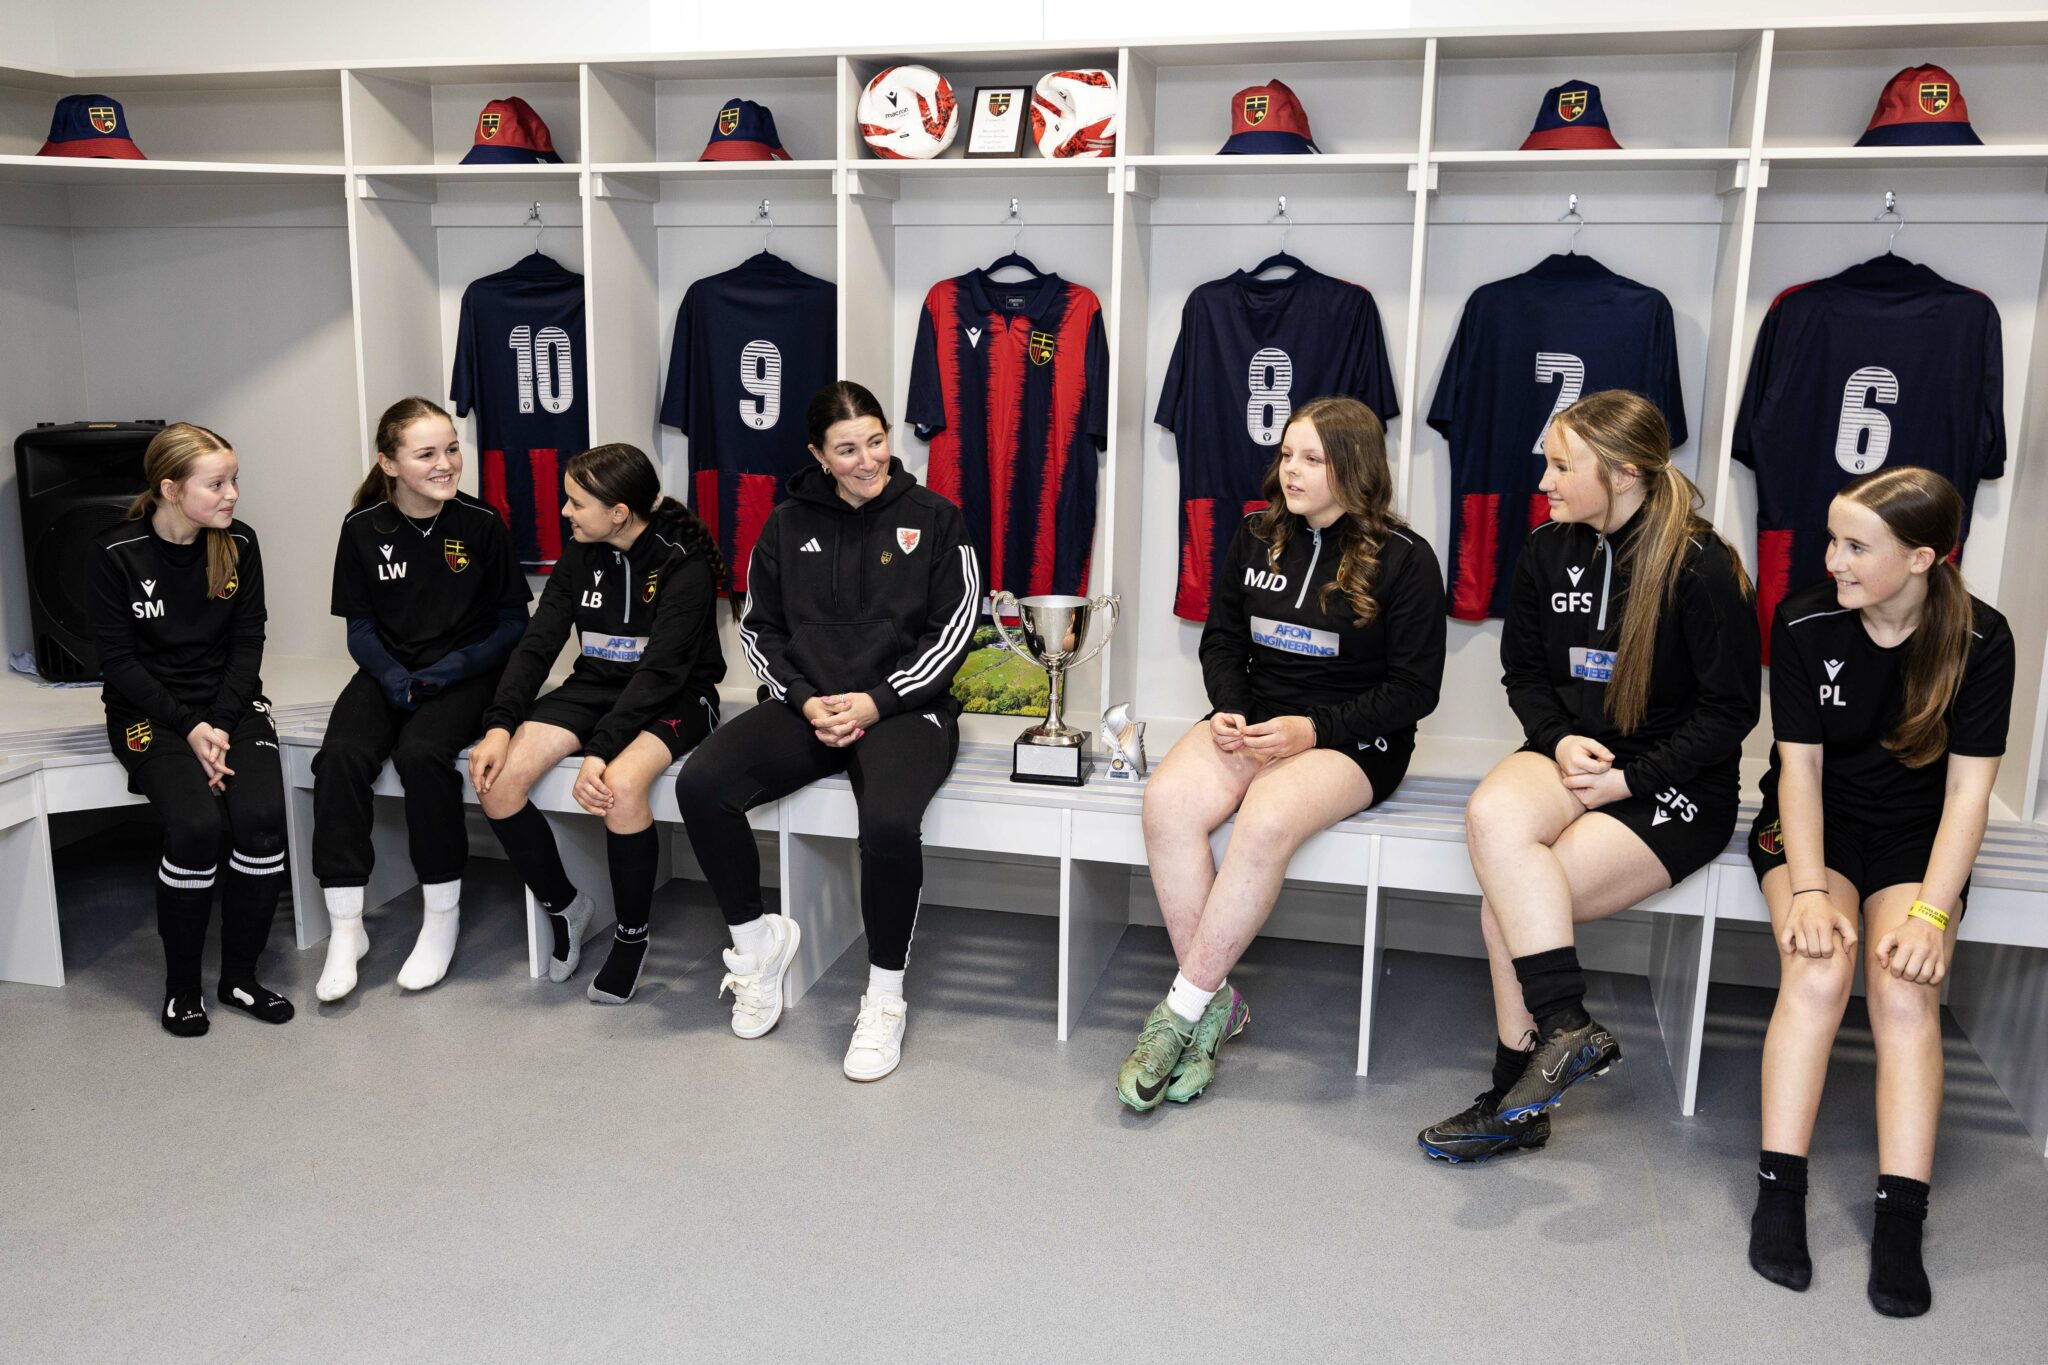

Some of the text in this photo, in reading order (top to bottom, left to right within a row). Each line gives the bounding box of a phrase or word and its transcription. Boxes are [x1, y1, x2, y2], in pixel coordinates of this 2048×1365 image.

[884, 107, 909, 119] macron
[509, 325, 574, 414] 10
[739, 339, 782, 430] 9
[1246, 347, 1293, 446] 8
[1531, 352, 1586, 455] 7
[1834, 366, 1899, 476] 6
[378, 561, 407, 581] LW
[1243, 567, 1288, 592] MJD
[131, 599, 165, 619] SM
[581, 590, 603, 609] LB
[1551, 591, 1594, 614] GFS
[1253, 631, 1336, 656] ENGINEERING
[1274, 623, 1312, 641] AFON
[1819, 684, 1847, 707] PL
